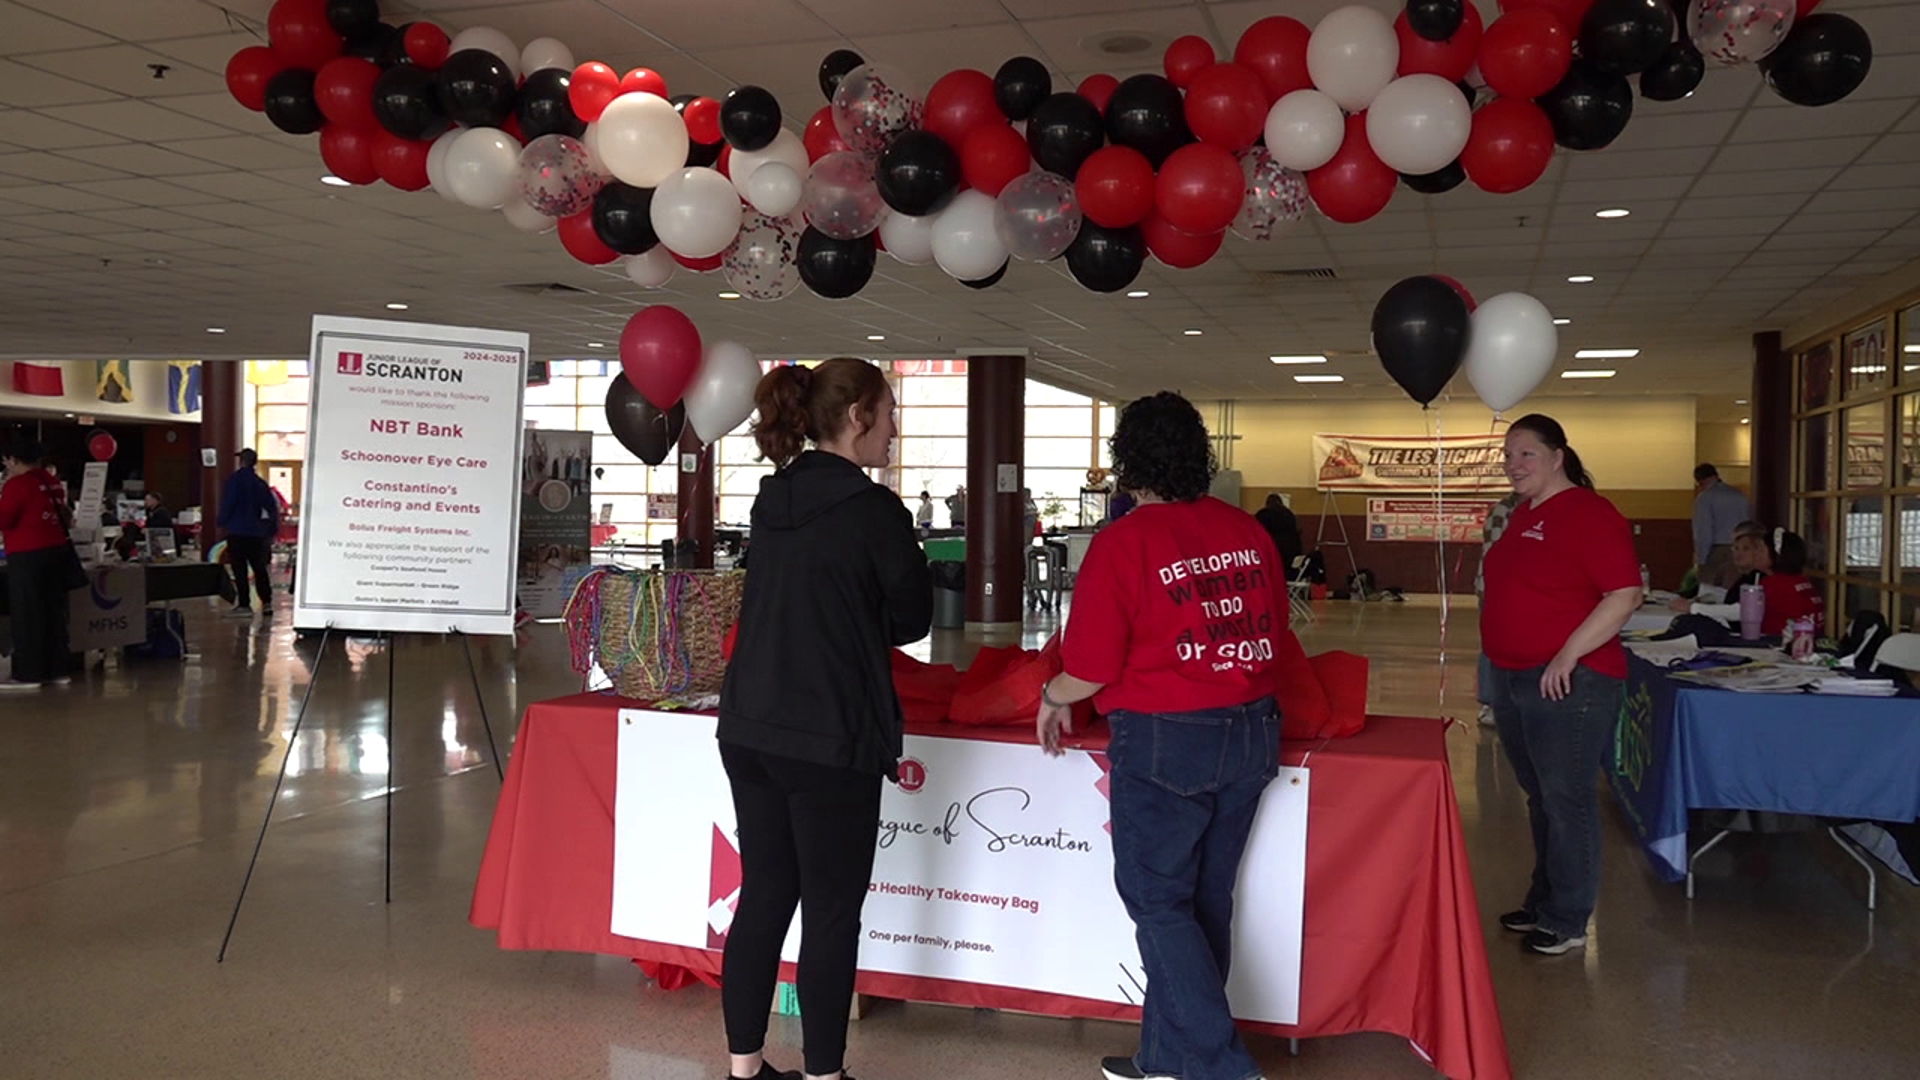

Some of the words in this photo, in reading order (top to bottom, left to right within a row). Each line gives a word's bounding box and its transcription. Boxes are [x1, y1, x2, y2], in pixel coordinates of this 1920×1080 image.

[365, 353, 396, 362] JUNIOR
[397, 356, 428, 365] LEAGUE
[430, 358, 442, 366] OF
[463, 351, 518, 364] 2024-2025
[365, 362, 463, 383] SCRANTON
[348, 385, 376, 394] would
[377, 386, 394, 395] like
[395, 387, 405, 396] to
[407, 388, 432, 397] thank
[433, 389, 449, 399] the
[450, 391, 490, 403] following
[370, 419, 410, 435] NBT
[417, 422, 463, 438] Bank
[341, 449, 423, 465] Schoonover
[427, 455, 452, 467] Eye
[456, 457, 488, 469] Care
[1370, 449, 1402, 464] THE
[1402, 449, 1433, 465] LES
[364, 480, 458, 496] Constantino's
[342, 497, 402, 512] Catering
[406, 500, 431, 512] and
[436, 502, 481, 514] Events
[378, 524, 411, 534] Freight
[414, 526, 452, 535] Systems
[327, 540, 343, 548] We
[346, 540, 362, 548] also
[365, 542, 411, 551] appreciate
[413, 543, 427, 552] the
[430, 545, 462, 554] support
[465, 546, 474, 554] of
[476, 546, 490, 555] the
[343, 551, 383, 561] following
[385, 553, 434, 564] community
[1158, 549, 1261, 585] DEVELOPING
[1201, 600, 1220, 619] TO
[1220, 596, 1243, 617] DO
[88, 615, 129, 634] MFHS
[1205, 612, 1272, 643] world
[1217, 638, 1273, 661] GOOD
[878, 818, 928, 849] ague
[932, 802, 961, 845] of
[966, 787, 1093, 852] Scranton
[880, 882, 934, 901] Healthy
[937, 887, 1009, 910] Takeaway
[1012, 896, 1040, 914] Bag
[868, 929, 892, 941] One
[893, 932, 912, 944] per
[913, 933, 952, 949] family,
[954, 940, 995, 953] please.
